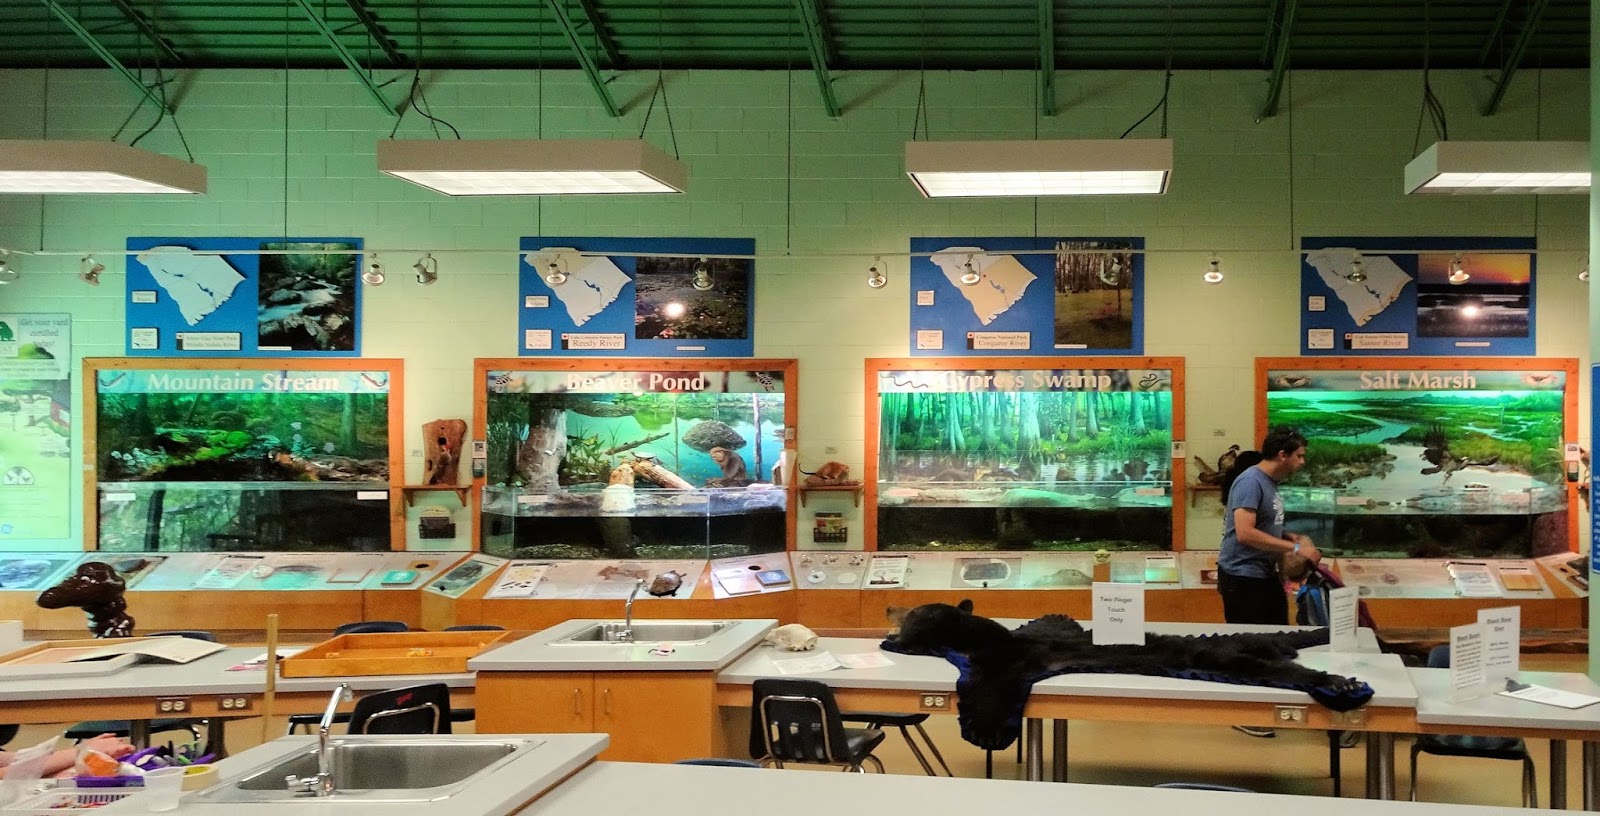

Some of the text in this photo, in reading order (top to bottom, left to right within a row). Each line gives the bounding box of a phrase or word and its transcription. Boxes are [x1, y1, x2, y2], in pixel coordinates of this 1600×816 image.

[572, 339, 622, 348] Reedy River
[148, 372, 340, 391] Mountain Stream
[566, 371, 705, 391] Beaver Pond
[944, 370, 1112, 392] Cypress Swamp
[1359, 369, 1477, 390] Salt Marsh
[1114, 596, 1133, 604] Finger
